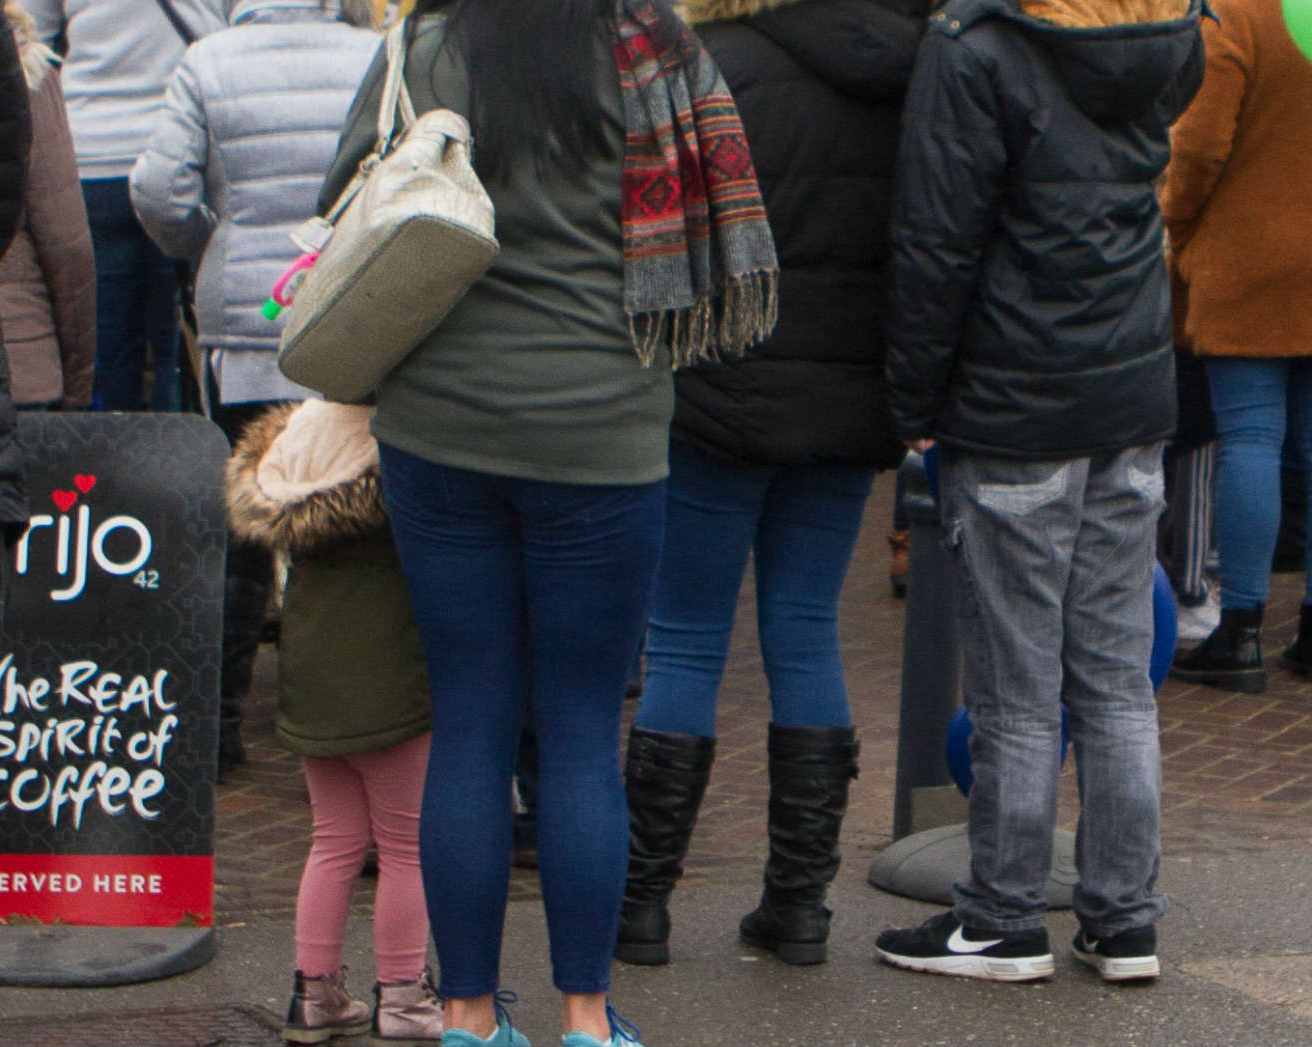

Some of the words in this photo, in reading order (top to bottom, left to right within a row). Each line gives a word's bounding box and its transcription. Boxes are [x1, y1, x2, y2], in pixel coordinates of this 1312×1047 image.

[15, 474, 153, 602] rijo
[133, 569, 161, 590] 42
[54, 660, 178, 719] REAL
[127, 714, 180, 768] of
[93, 873, 164, 894] HERE
